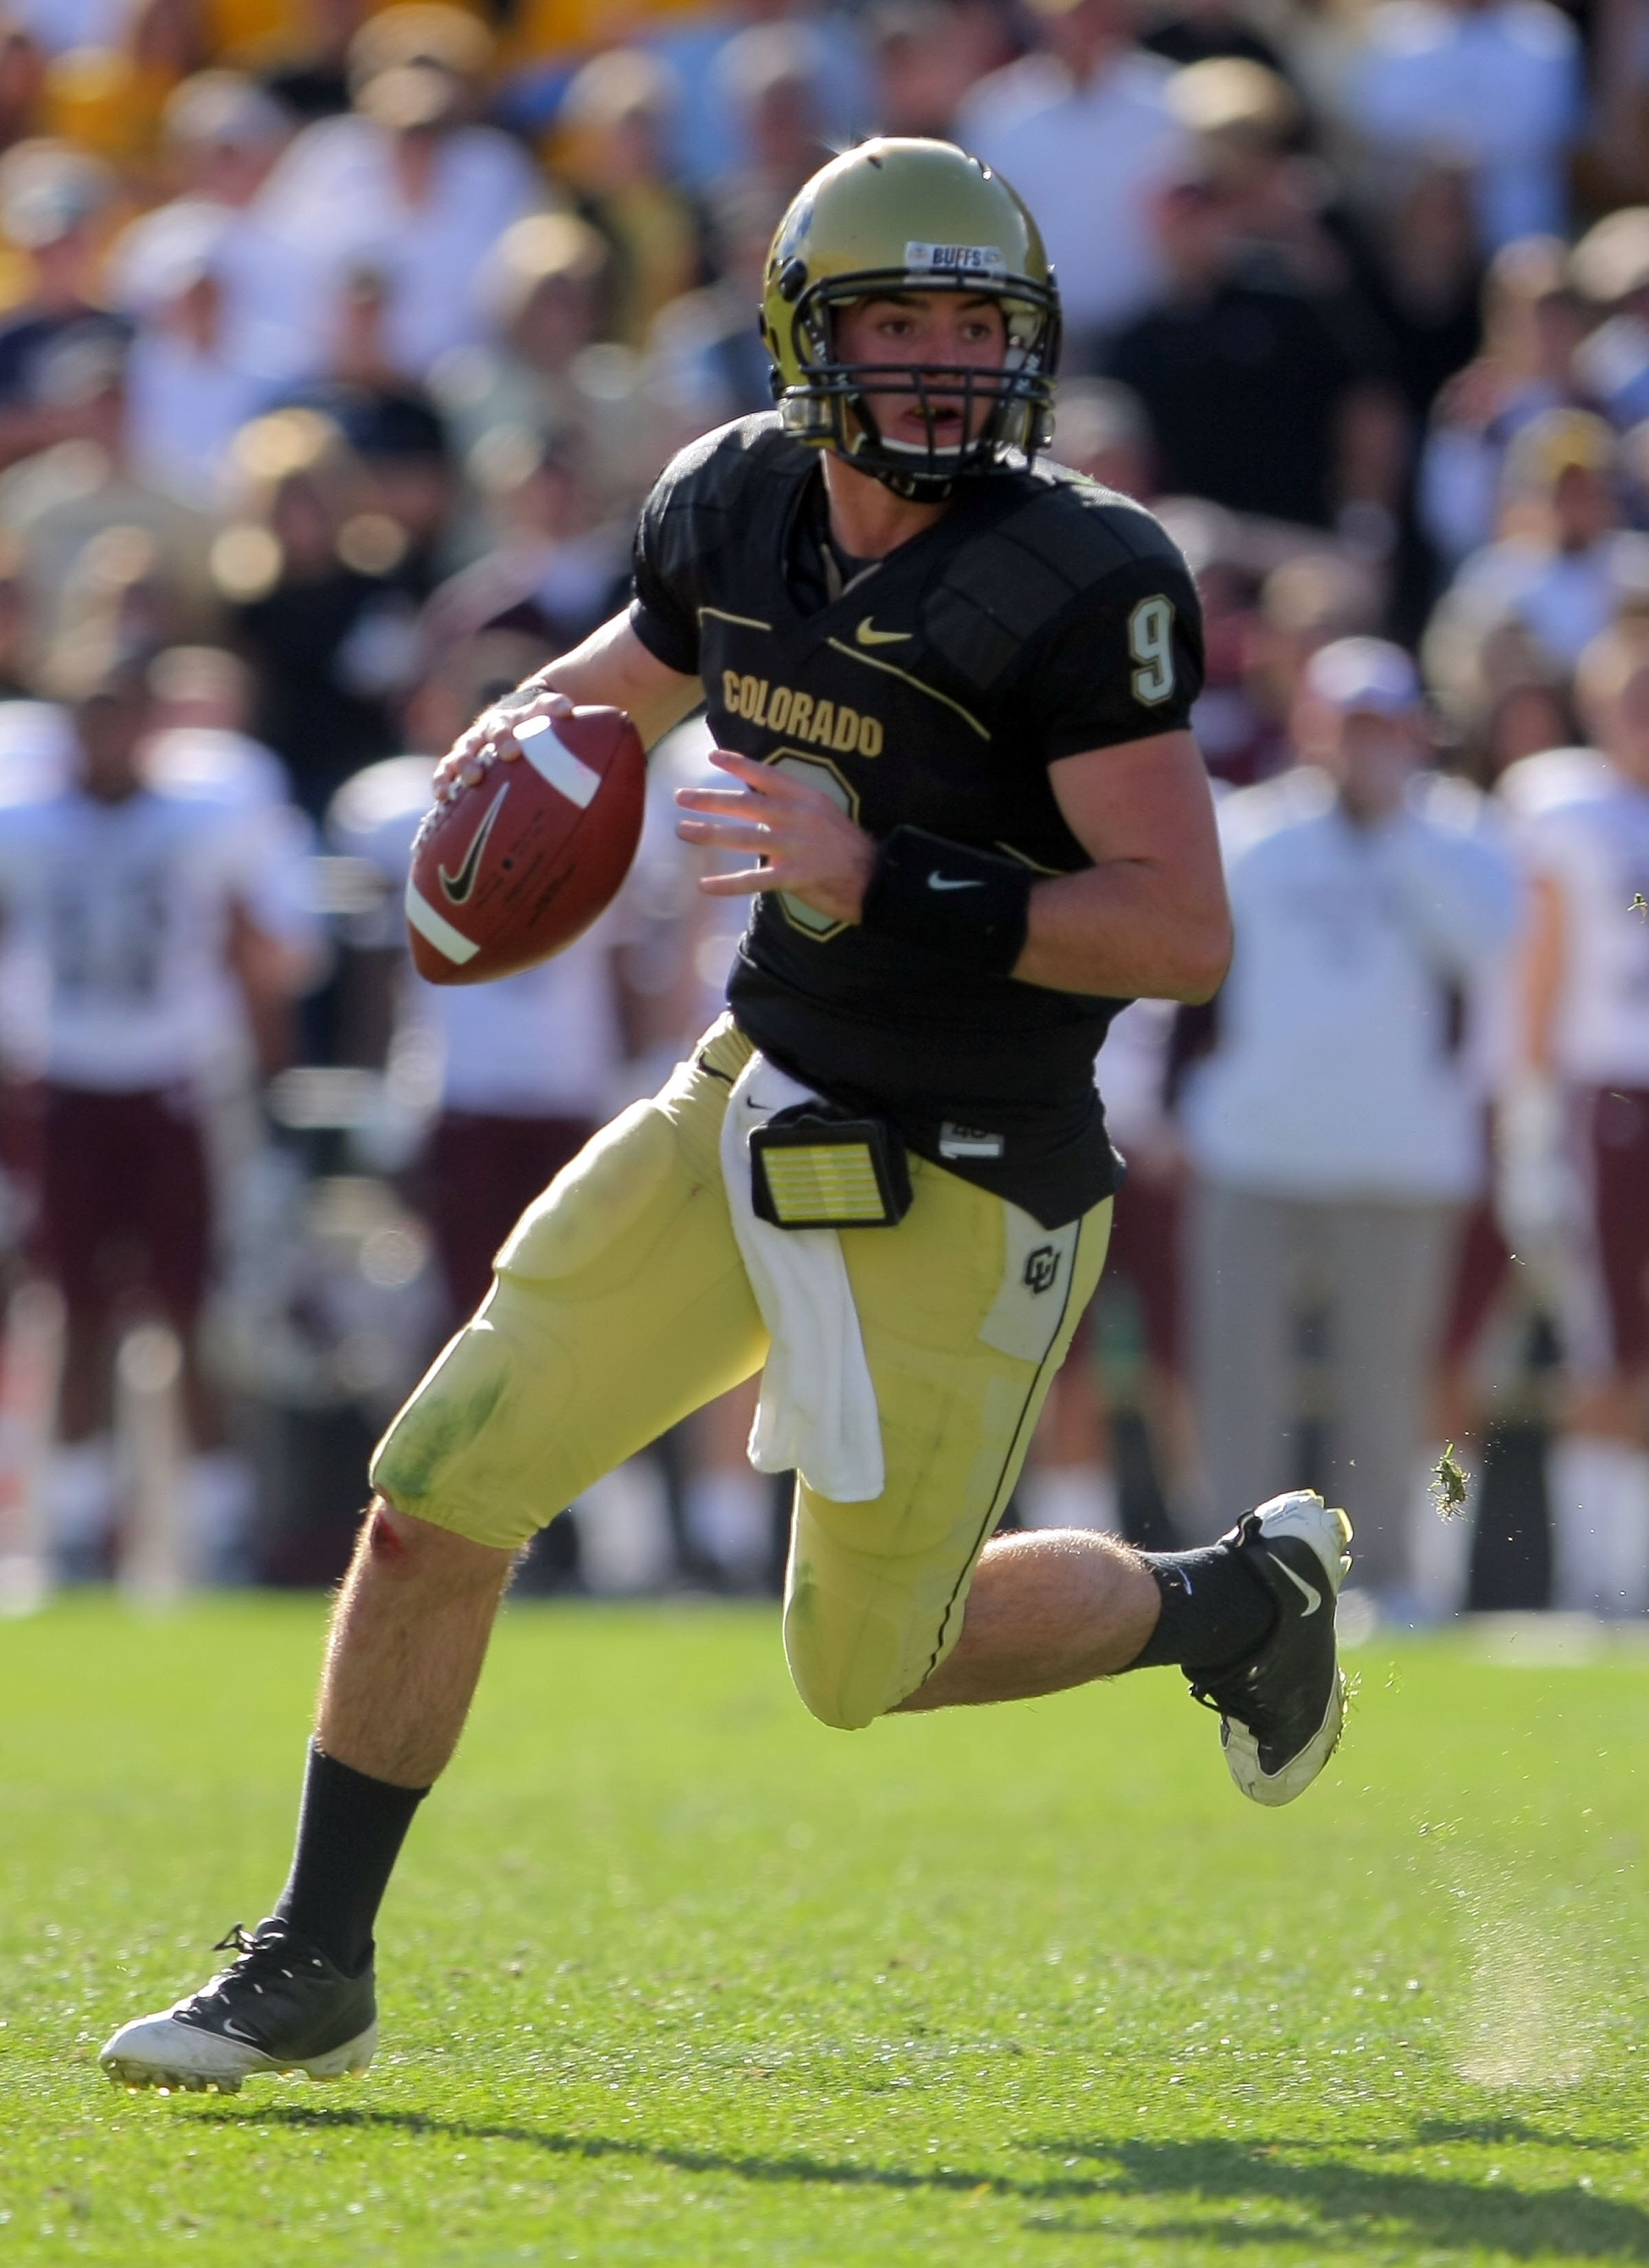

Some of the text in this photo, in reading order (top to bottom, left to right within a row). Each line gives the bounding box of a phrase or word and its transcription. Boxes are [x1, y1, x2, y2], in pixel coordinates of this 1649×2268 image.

[932, 247, 982, 267] BUFFS
[1128, 593, 1176, 707] 9
[722, 669, 884, 758] COLORADO
